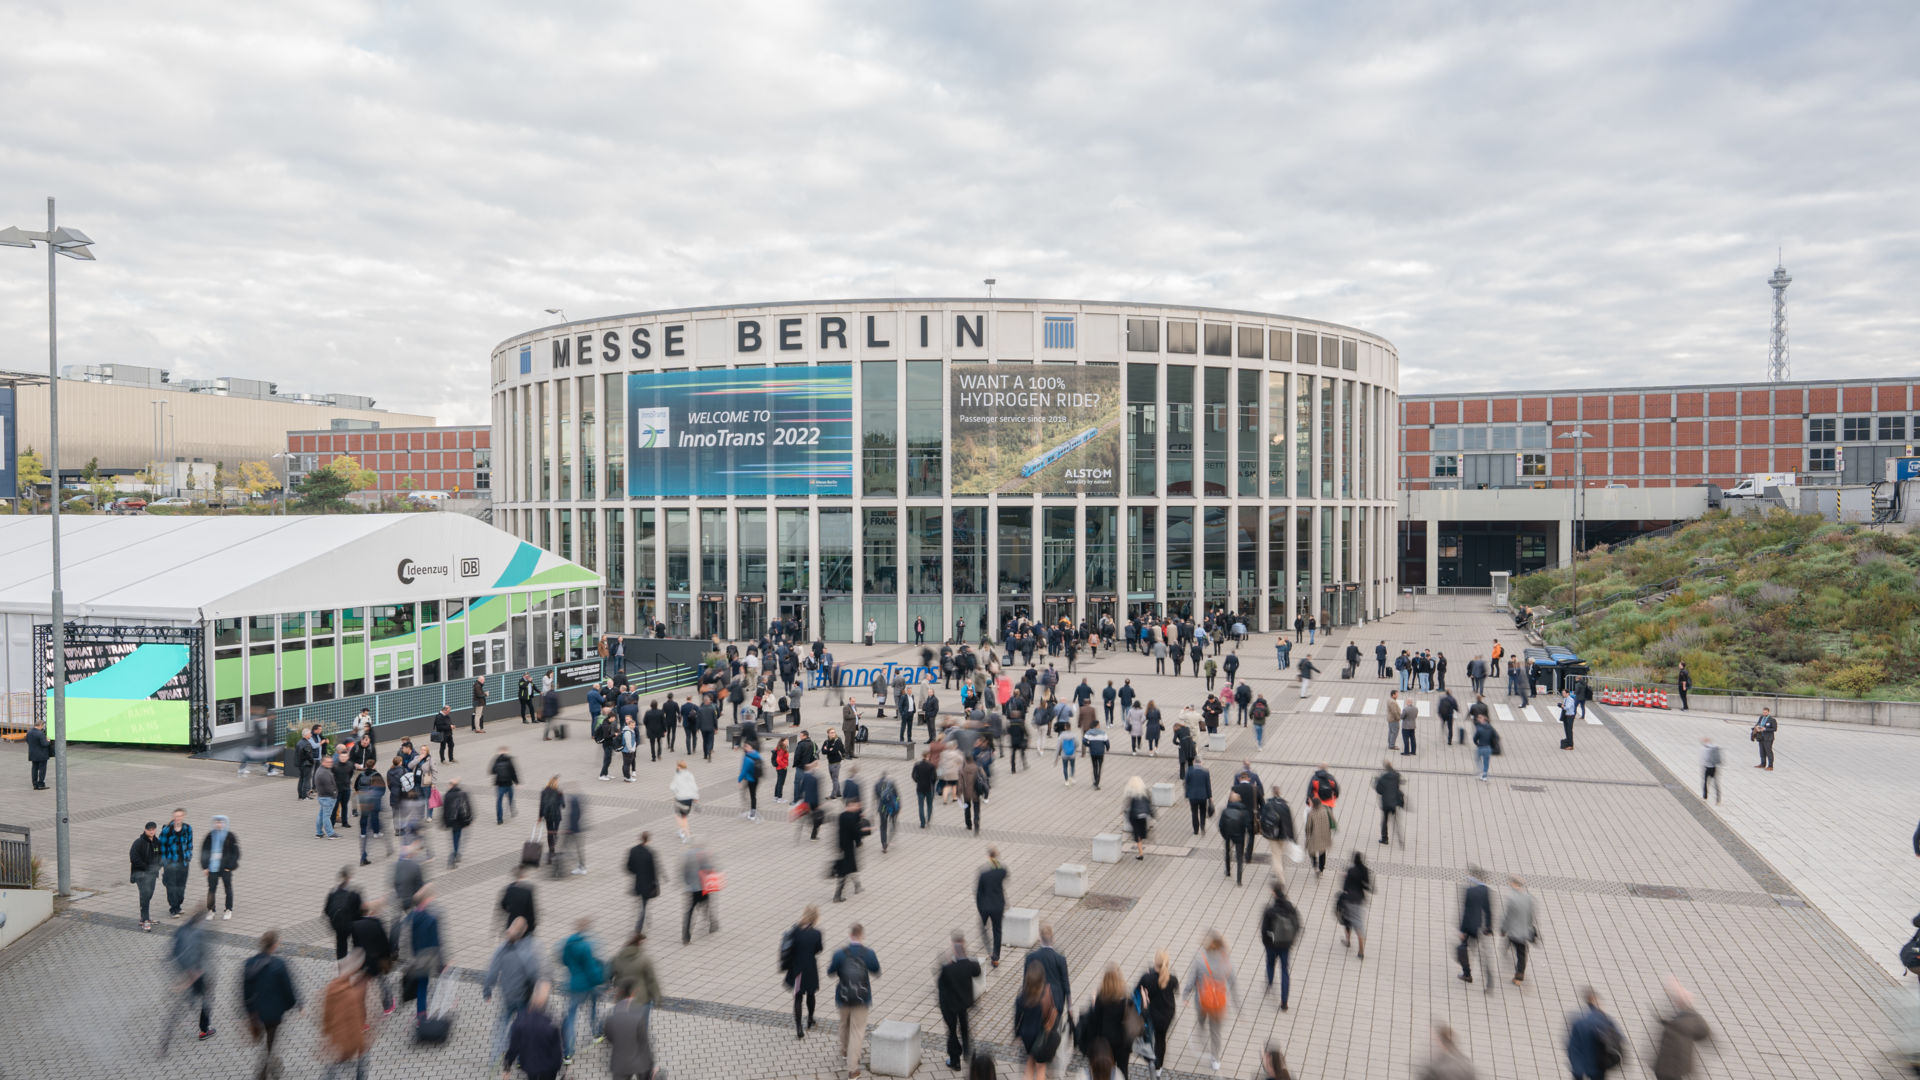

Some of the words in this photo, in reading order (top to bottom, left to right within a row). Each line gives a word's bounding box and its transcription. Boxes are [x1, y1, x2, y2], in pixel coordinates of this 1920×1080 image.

[552, 324, 685, 369] MESSE
[738, 315, 984, 353] BERLIN
[960, 375, 1009, 389] WANT
[1013, 375, 1024, 389] A
[1029, 377, 1066, 390] 100%
[960, 392, 1051, 407] HYDROGEN
[1057, 393, 1100, 408] RIDE?
[688, 410, 750, 424] WELCOME
[753, 410, 771, 422] TO
[960, 415, 998, 425] Passenger
[1000, 415, 1026, 423] service
[1028, 415, 1046, 423] since
[678, 429, 766, 448] InnoTrans
[772, 427, 821, 446] 2022
[1064, 468, 1112, 479] ALSTOM
[407, 565, 448, 576] Ideenzug
[462, 560, 479, 576] DB
[64, 646, 93, 658] WHAT
[105, 643, 137, 655] TRAINS
[66, 658, 95, 671] WHAT
[816, 662, 939, 688] #nnoTans
